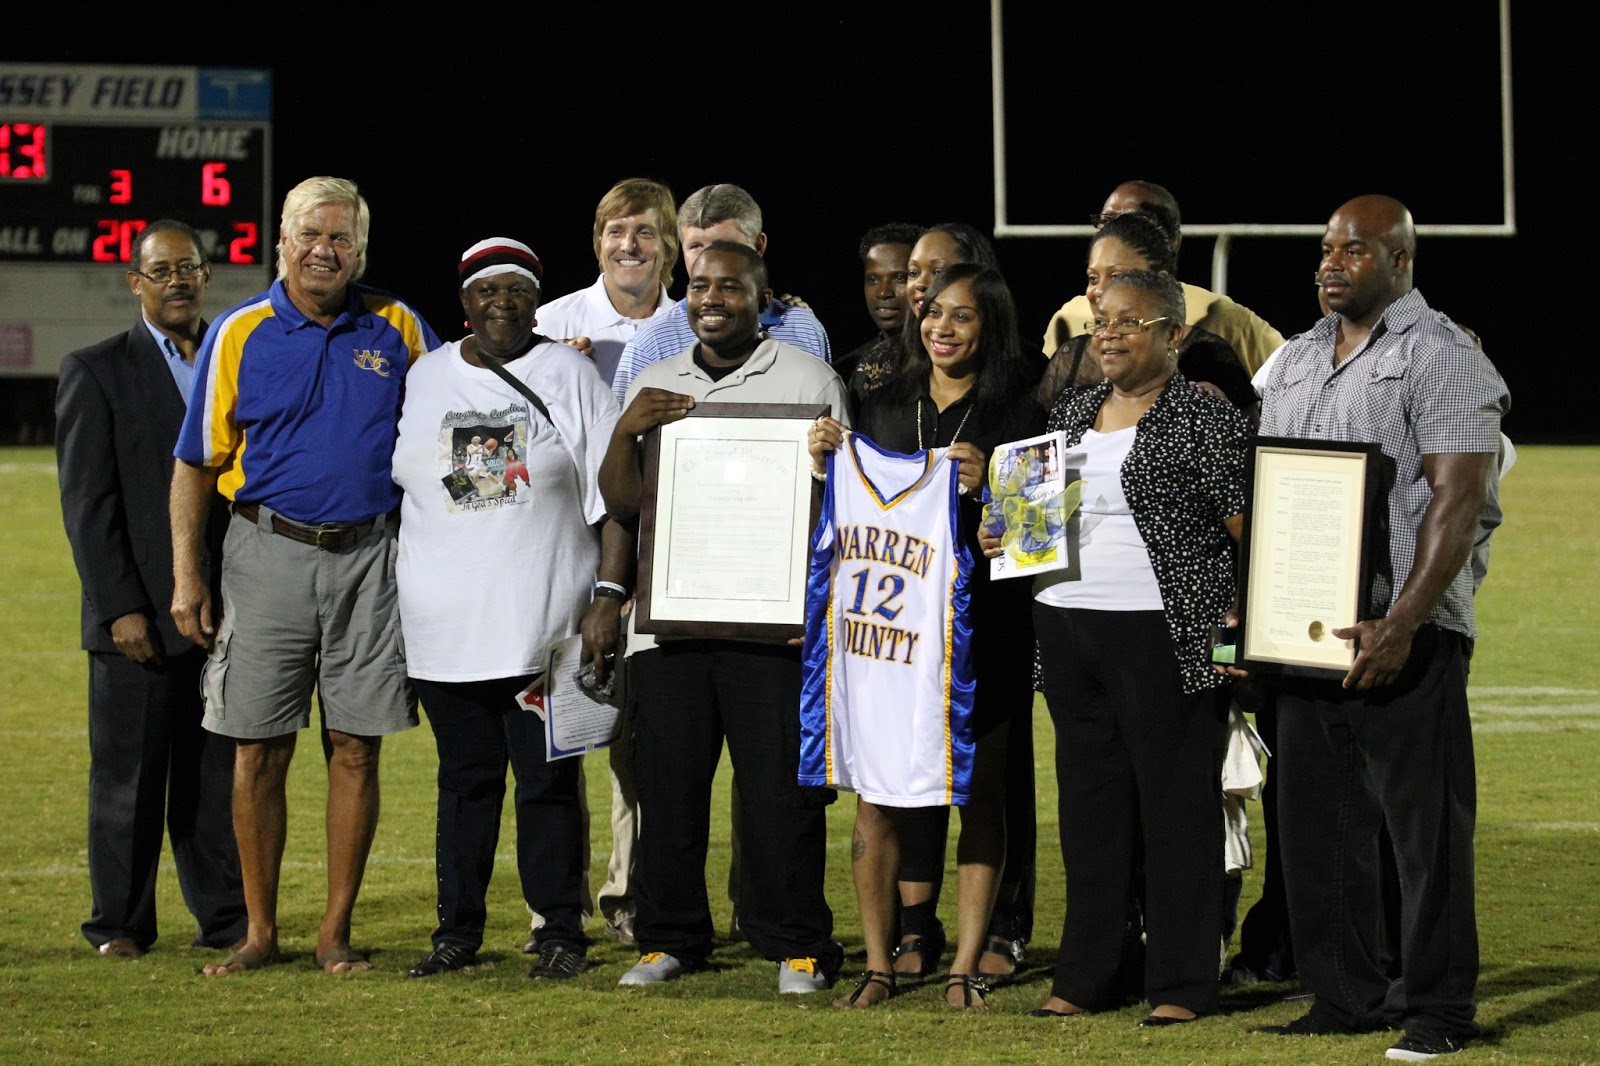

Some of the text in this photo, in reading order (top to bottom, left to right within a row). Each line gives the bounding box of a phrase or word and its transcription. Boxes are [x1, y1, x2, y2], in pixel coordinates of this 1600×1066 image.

[92, 75, 185, 108] FIELD
[156, 128, 250, 160] HOME
[109, 169, 132, 204] 3
[202, 162, 231, 206] 6
[52, 227, 89, 254] ON
[229, 222, 257, 264] 2
[846, 567, 905, 621] 12
